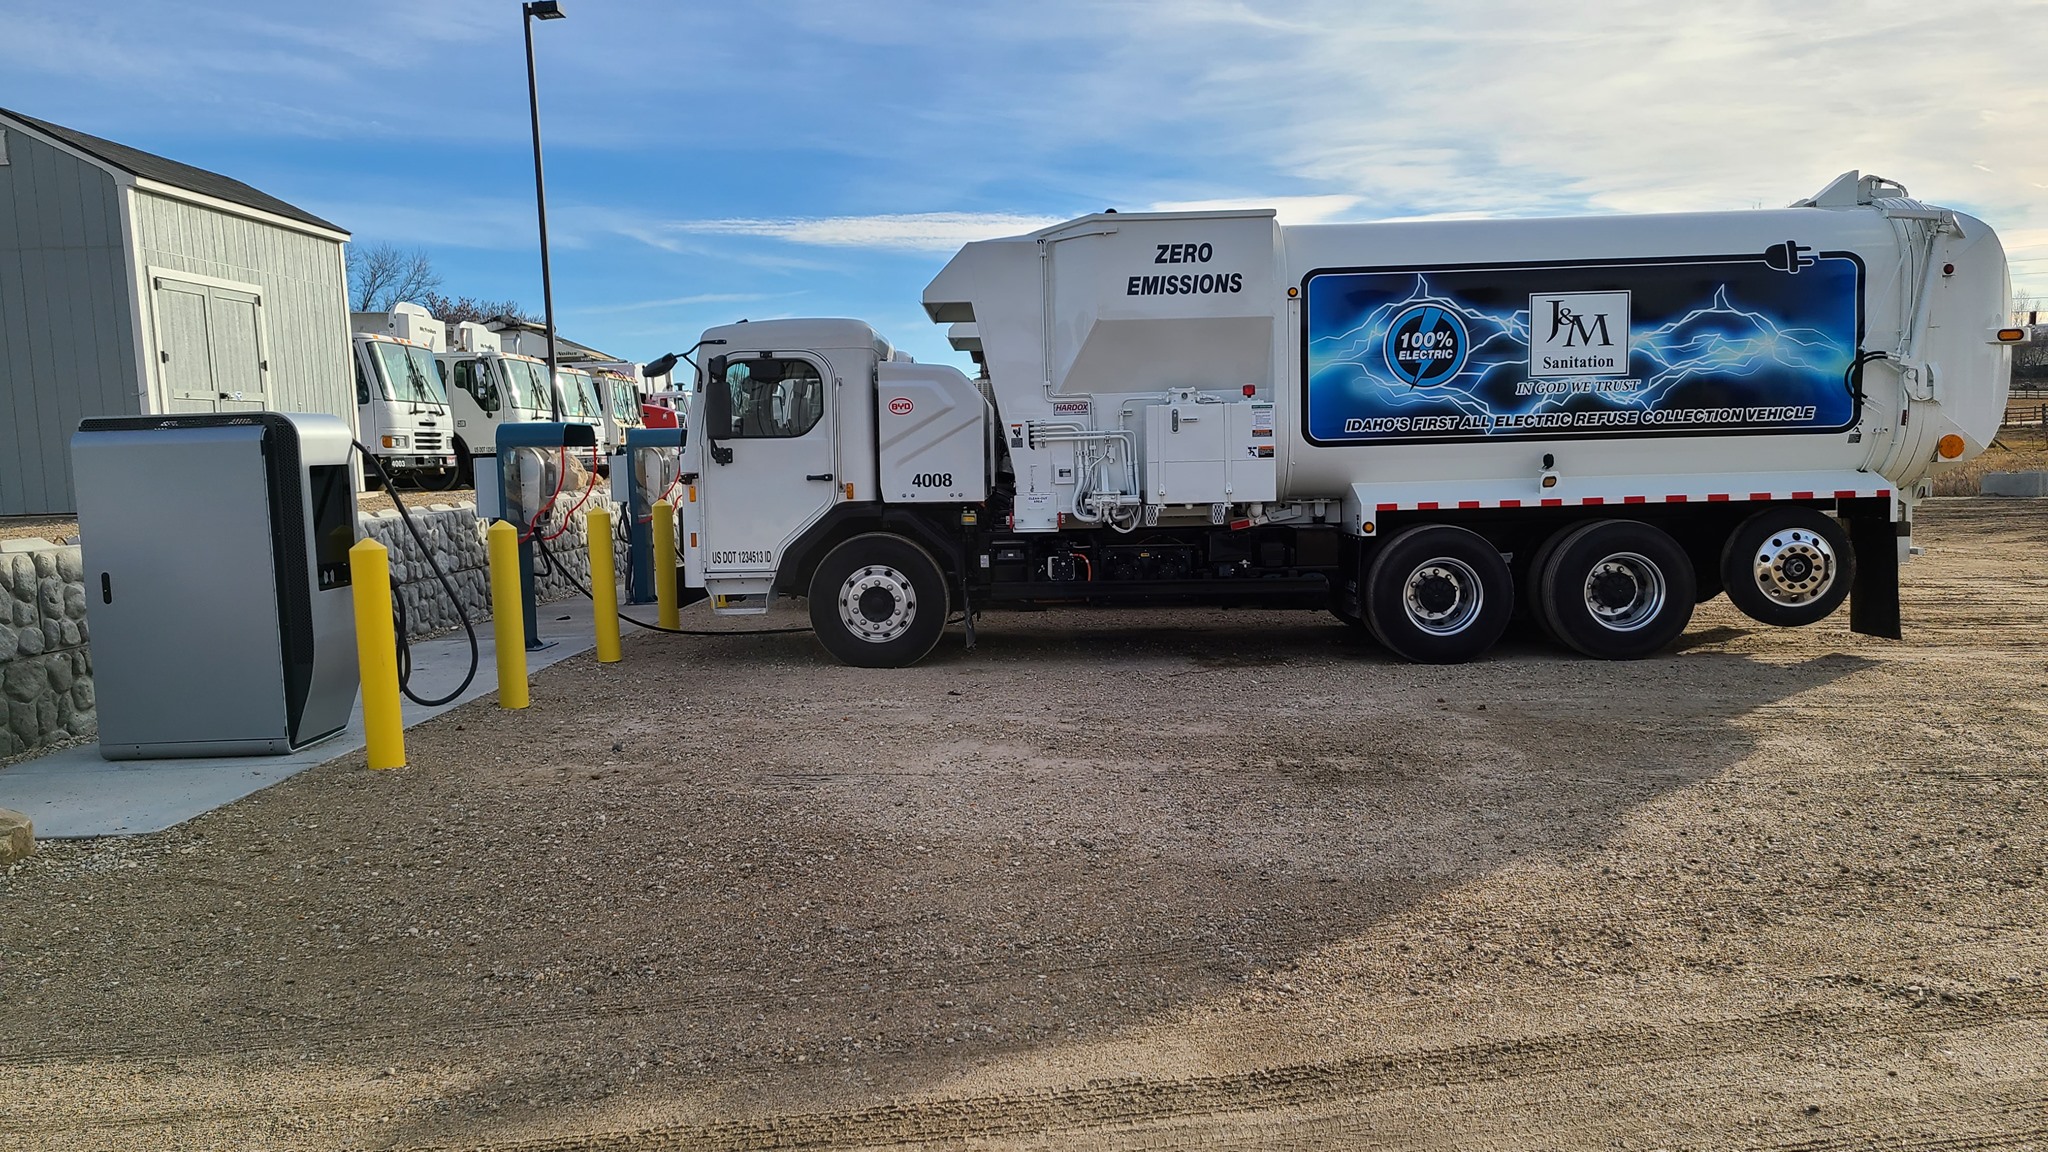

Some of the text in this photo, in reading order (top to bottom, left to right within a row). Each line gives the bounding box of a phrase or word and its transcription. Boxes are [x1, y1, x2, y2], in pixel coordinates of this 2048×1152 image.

[1155, 243, 1213, 264] ZERO
[1127, 273, 1242, 295] EMISSIONS
[1546, 300, 1614, 347] J&M
[1401, 331, 1453, 348] 100%
[1399, 350, 1453, 360] ELECTRIC
[1543, 355, 1614, 369] Sanitation
[1516, 379, 1640, 395] IN GOD WE TRUST
[891, 402, 911, 411] BYD
[1056, 403, 1088, 411] HARDOX
[1345, 406, 1816, 432] IDAHO'S FIRST ALL ELECTRIC REFUSE COLLECTION VEHICLE
[912, 473, 952, 487] 4008
[712, 551, 772, 564] US DOT 1234513 ID
